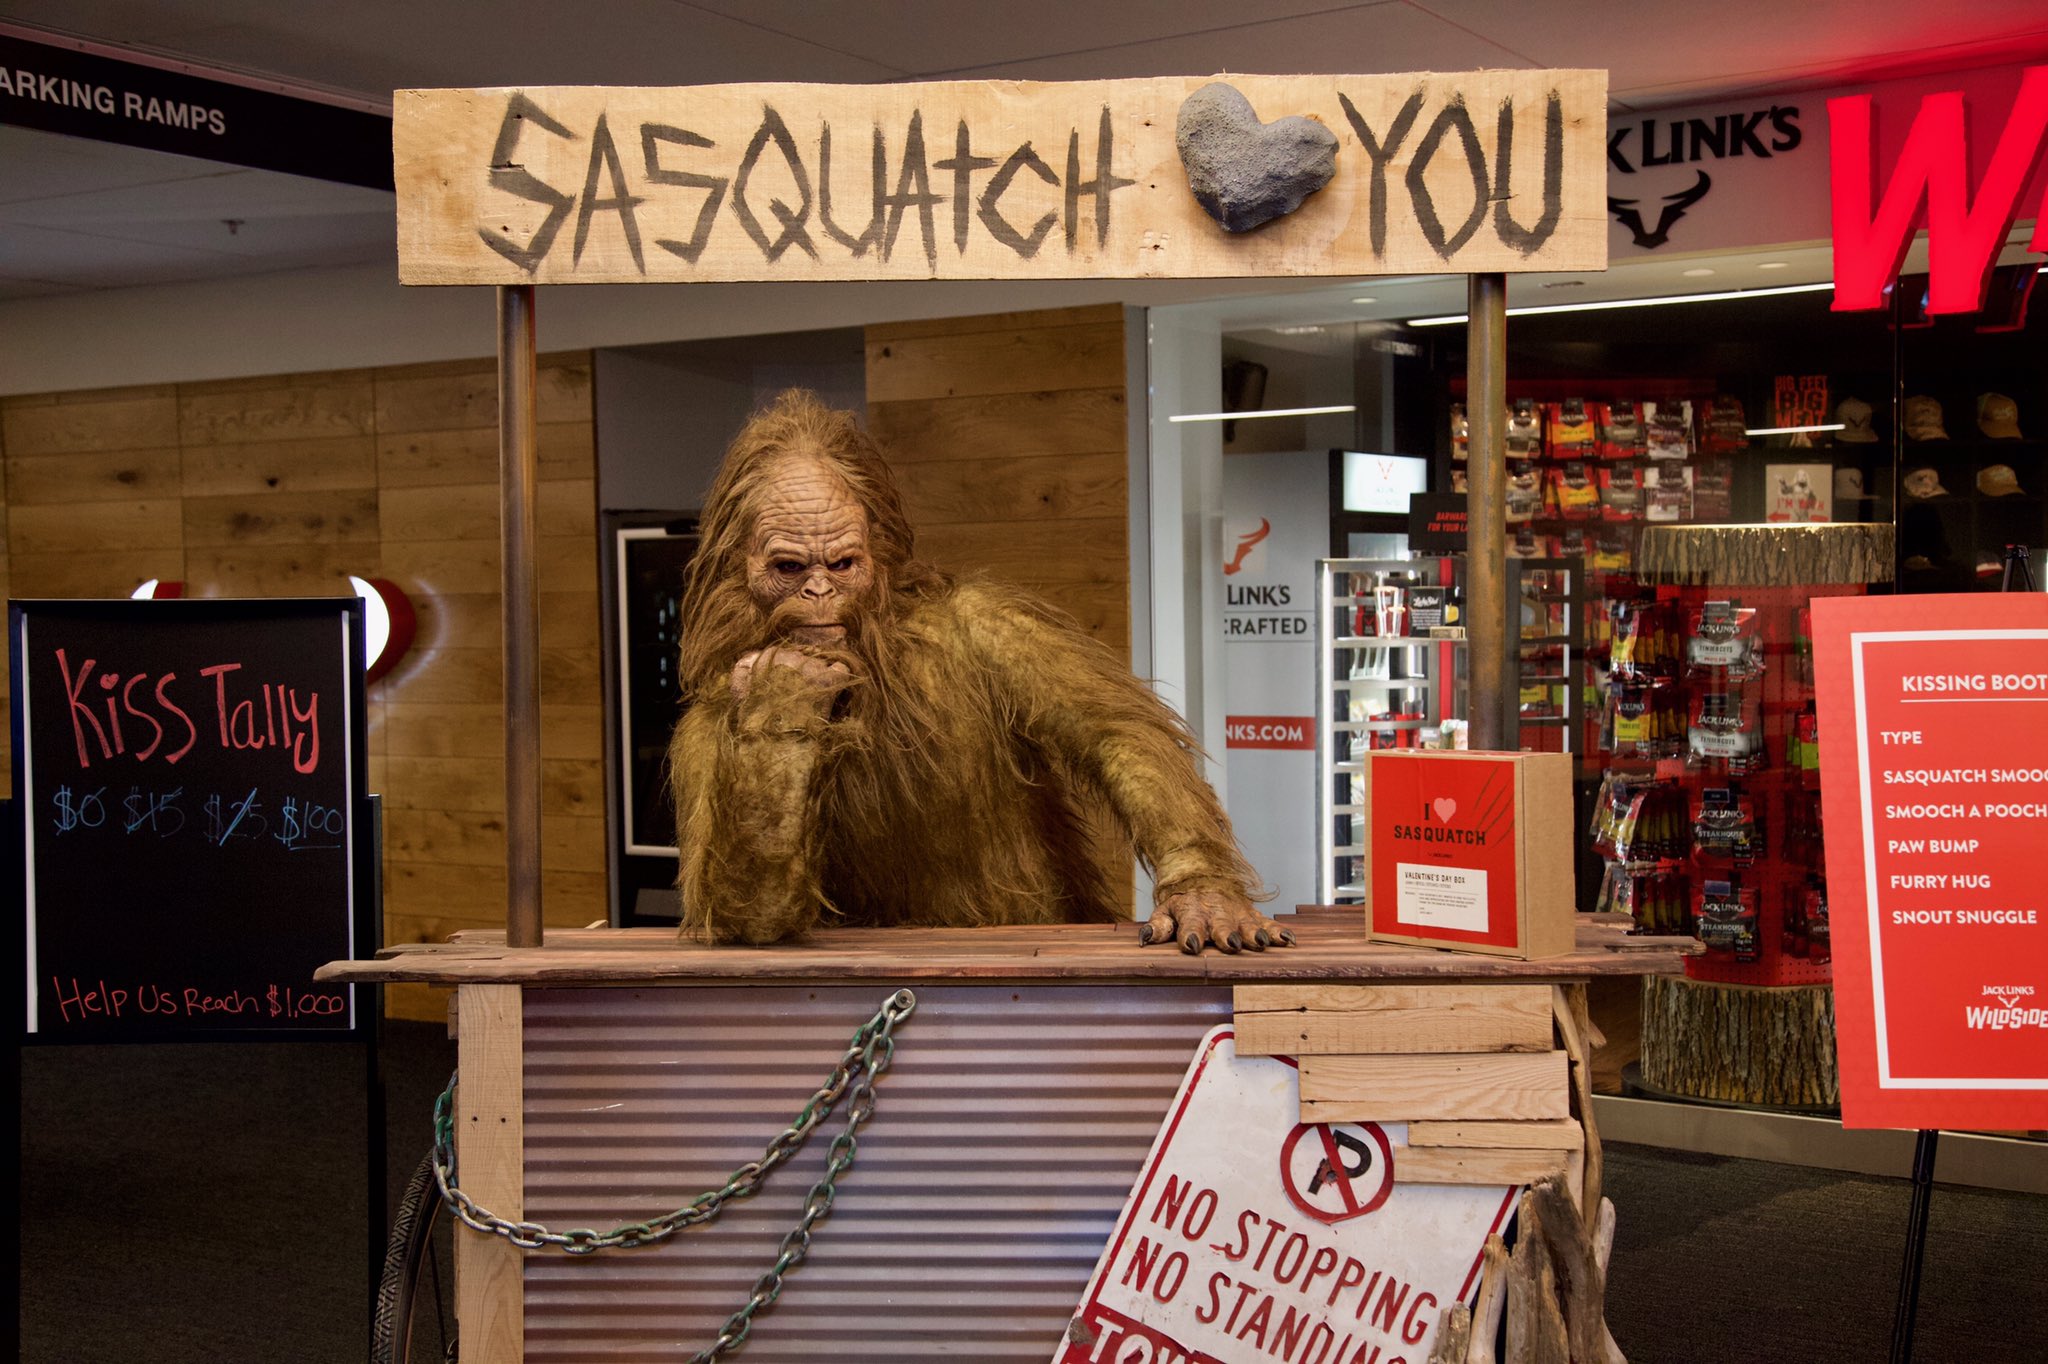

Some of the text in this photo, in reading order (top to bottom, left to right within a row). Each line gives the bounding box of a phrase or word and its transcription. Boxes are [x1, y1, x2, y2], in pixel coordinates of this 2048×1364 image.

[124, 92, 226, 135] RAMPS
[1641, 105, 1802, 167] LINK'S
[478, 80, 1563, 276] SASQUATCH YOU
[1227, 584, 1290, 606] LINK'S
[1224, 618, 1307, 634] RAFTED
[1902, 674, 2048, 692] KISSING BOOT
[201, 663, 318, 774] Tally
[1880, 731, 1923, 745] TYPE
[1883, 769, 1987, 787] SASQUATCH
[1423, 803, 1430, 820] I
[1886, 804, 2048, 818] SMOOCH A POOCH
[274, 796, 344, 847] $100
[1394, 825, 1486, 845] SASQUATCH
[1888, 839, 1979, 853] PAW BUMP
[1405, 871, 1466, 884] VALENTINE'S DAY BOX
[1890, 875, 1991, 888] FURRY HUG
[1892, 910, 2037, 924] SNOUT SNUGGLE
[54, 976, 344, 1022] Help Us Reach $1,000
[1982, 985, 2035, 996] JACK LINK'S
[1150, 1174, 1438, 1345] NO STOPPING
[1121, 1236, 1407, 1364] NO STANDI
